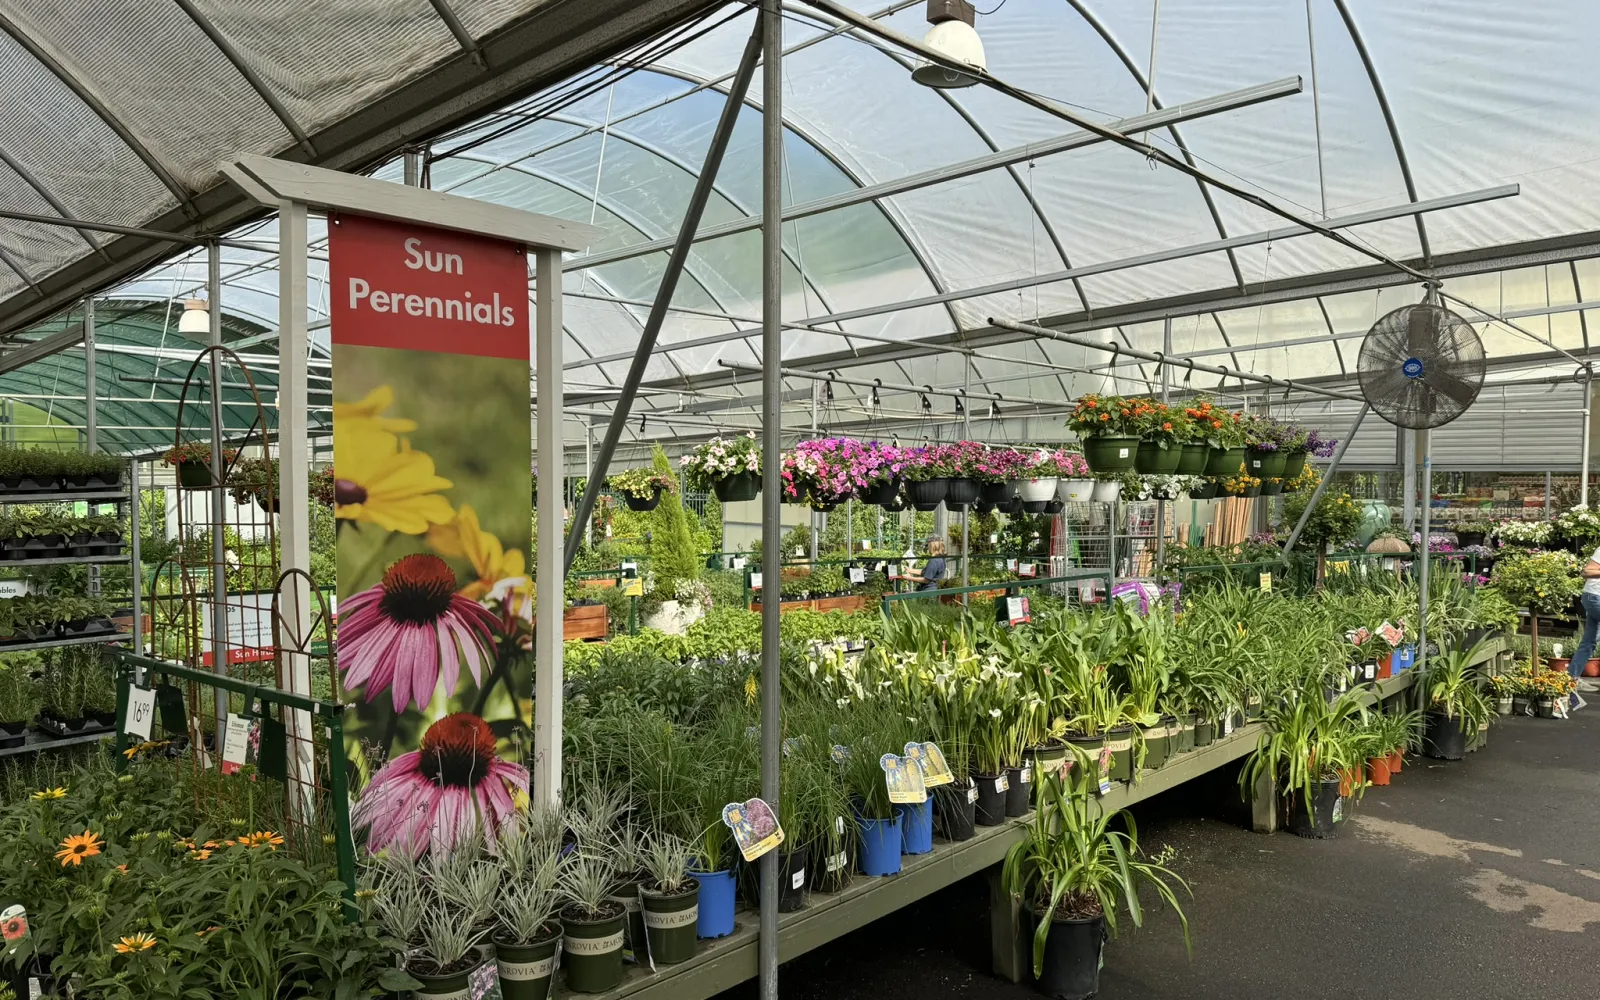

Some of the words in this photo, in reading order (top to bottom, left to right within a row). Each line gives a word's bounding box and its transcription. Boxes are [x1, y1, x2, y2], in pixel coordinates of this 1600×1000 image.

[403, 237, 464, 275] Sun
[348, 277, 515, 327] Perennials
[252, 647, 274, 656] Hrbs
